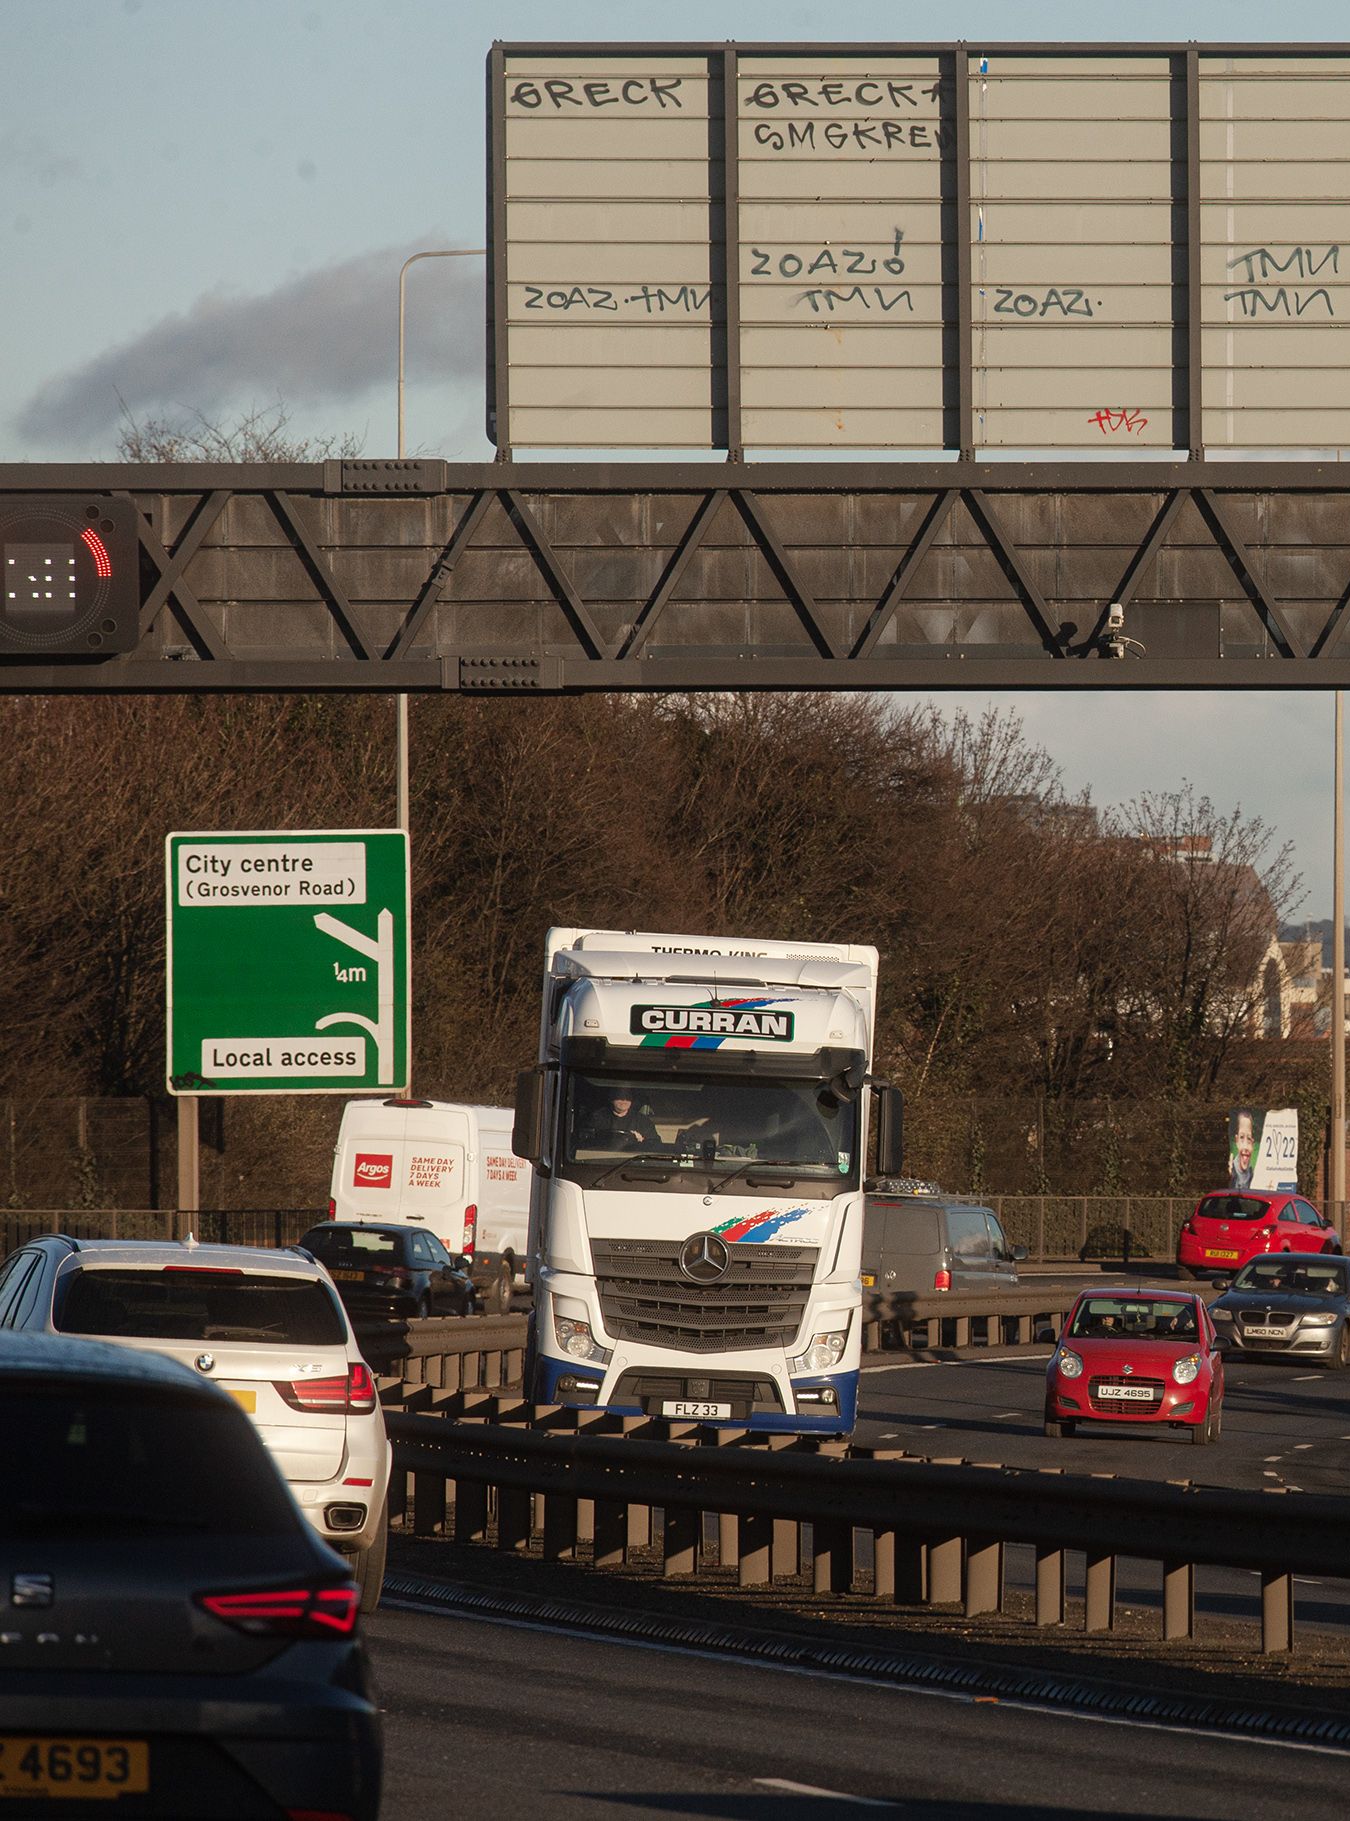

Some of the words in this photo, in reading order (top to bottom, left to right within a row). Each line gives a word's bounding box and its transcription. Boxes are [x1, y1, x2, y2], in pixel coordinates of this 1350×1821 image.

[186, 854, 231, 876] City
[240, 854, 313, 872] centre
[186, 879, 290, 898] (Grosvenor
[299, 878, 355, 896] Road)
[641, 1010, 787, 1036] CURRAN
[213, 1048, 273, 1067] Local
[281, 1050, 356, 1066] access
[411, 1156, 435, 1165] SAME
[436, 1157, 455, 1166] DAY
[357, 1162, 389, 1176] Argos
[410, 1164, 454, 1173] DELIVERY
[416, 1172, 440, 1180] DAYS
[1101, 1388, 1121, 1397] UJZ
[1124, 1389, 1151, 1398] 4695
[675, 1403, 700, 1416] FLZ
[702, 1404, 719, 1416] 33
[20, 1745, 131, 1784] 4693
